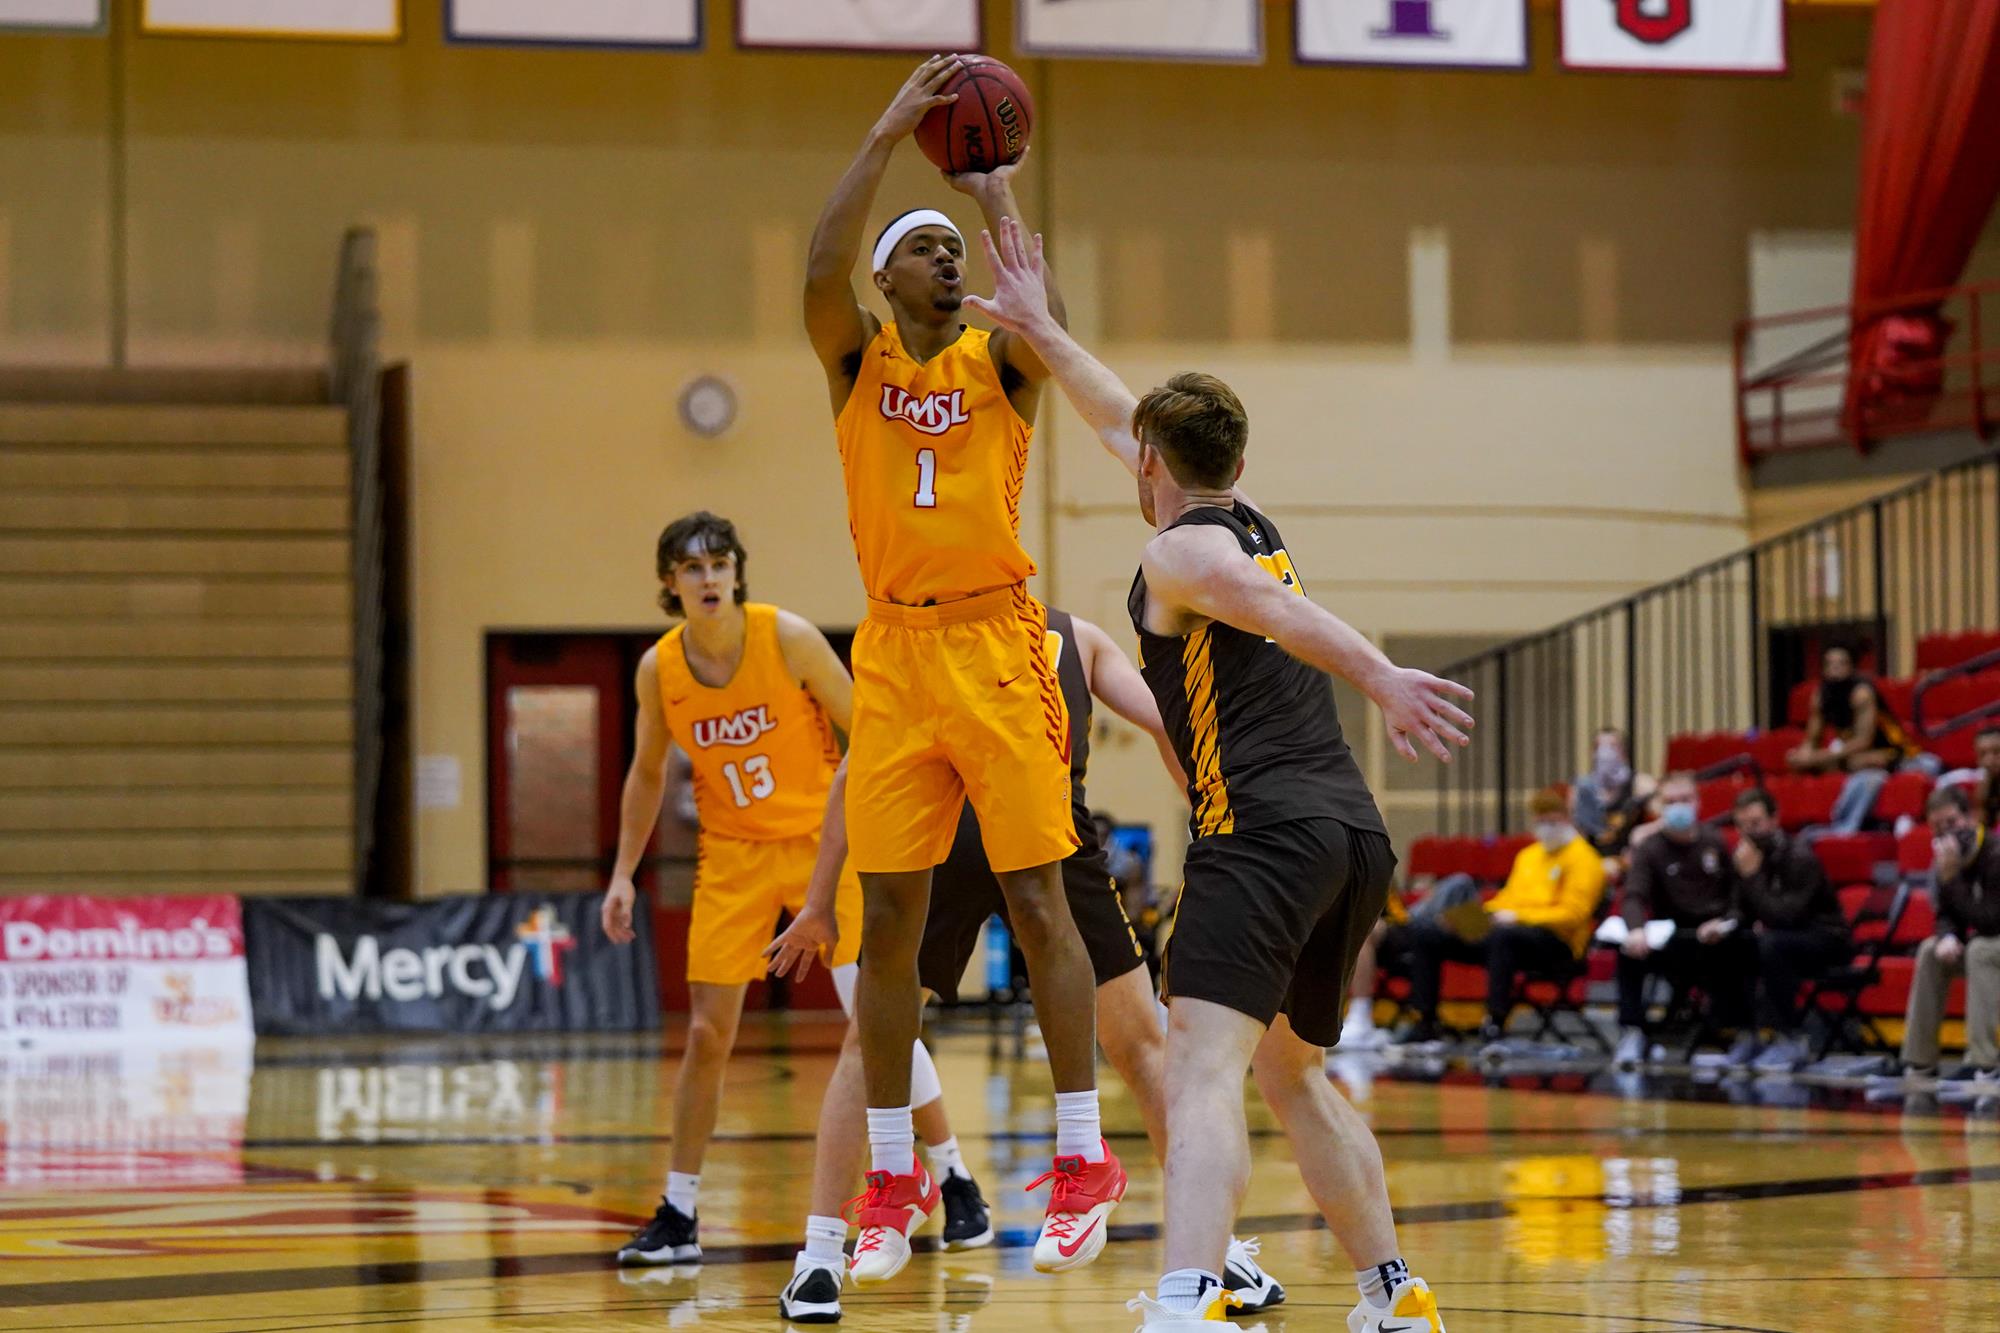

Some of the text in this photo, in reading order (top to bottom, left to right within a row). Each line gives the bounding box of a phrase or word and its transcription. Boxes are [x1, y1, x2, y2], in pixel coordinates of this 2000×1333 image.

[880, 383, 971, 436] UMSL
[914, 448, 937, 508] 1
[692, 704, 777, 750] UMSL
[723, 754, 776, 807] 13
[3, 916, 232, 959] Domino's
[315, 932, 527, 1010] Mercy
